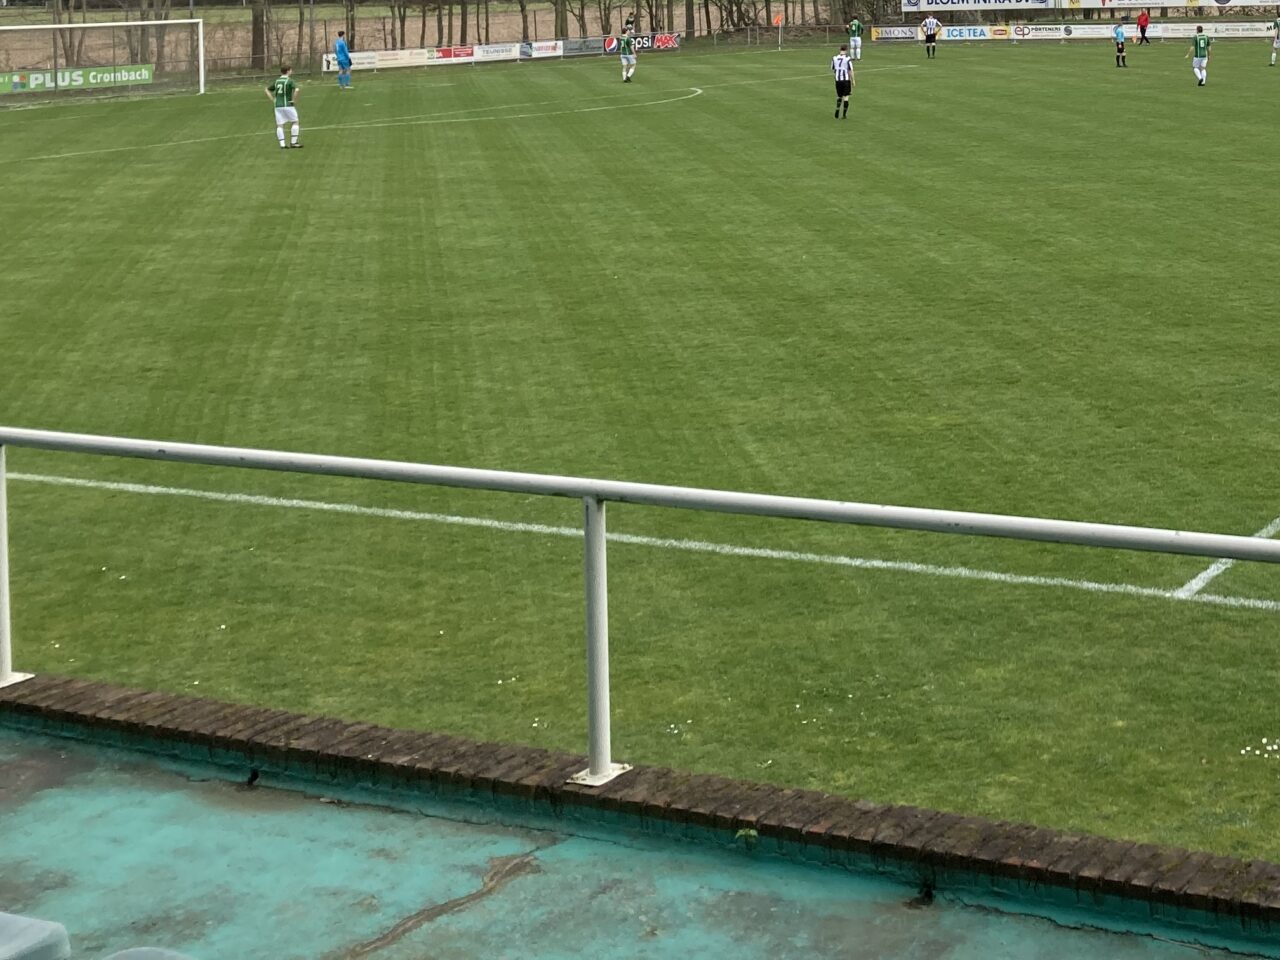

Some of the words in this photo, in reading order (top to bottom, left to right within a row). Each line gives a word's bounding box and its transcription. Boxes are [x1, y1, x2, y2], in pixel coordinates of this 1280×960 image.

[874, 28, 914, 37] SIMONS
[946, 28, 964, 38] ICE
[966, 28, 986, 38] TEA
[631, 36, 652, 50] epsi
[654, 33, 680, 49] MAX
[29, 71, 84, 89] PLUS
[88, 69, 149, 85] Crombach
